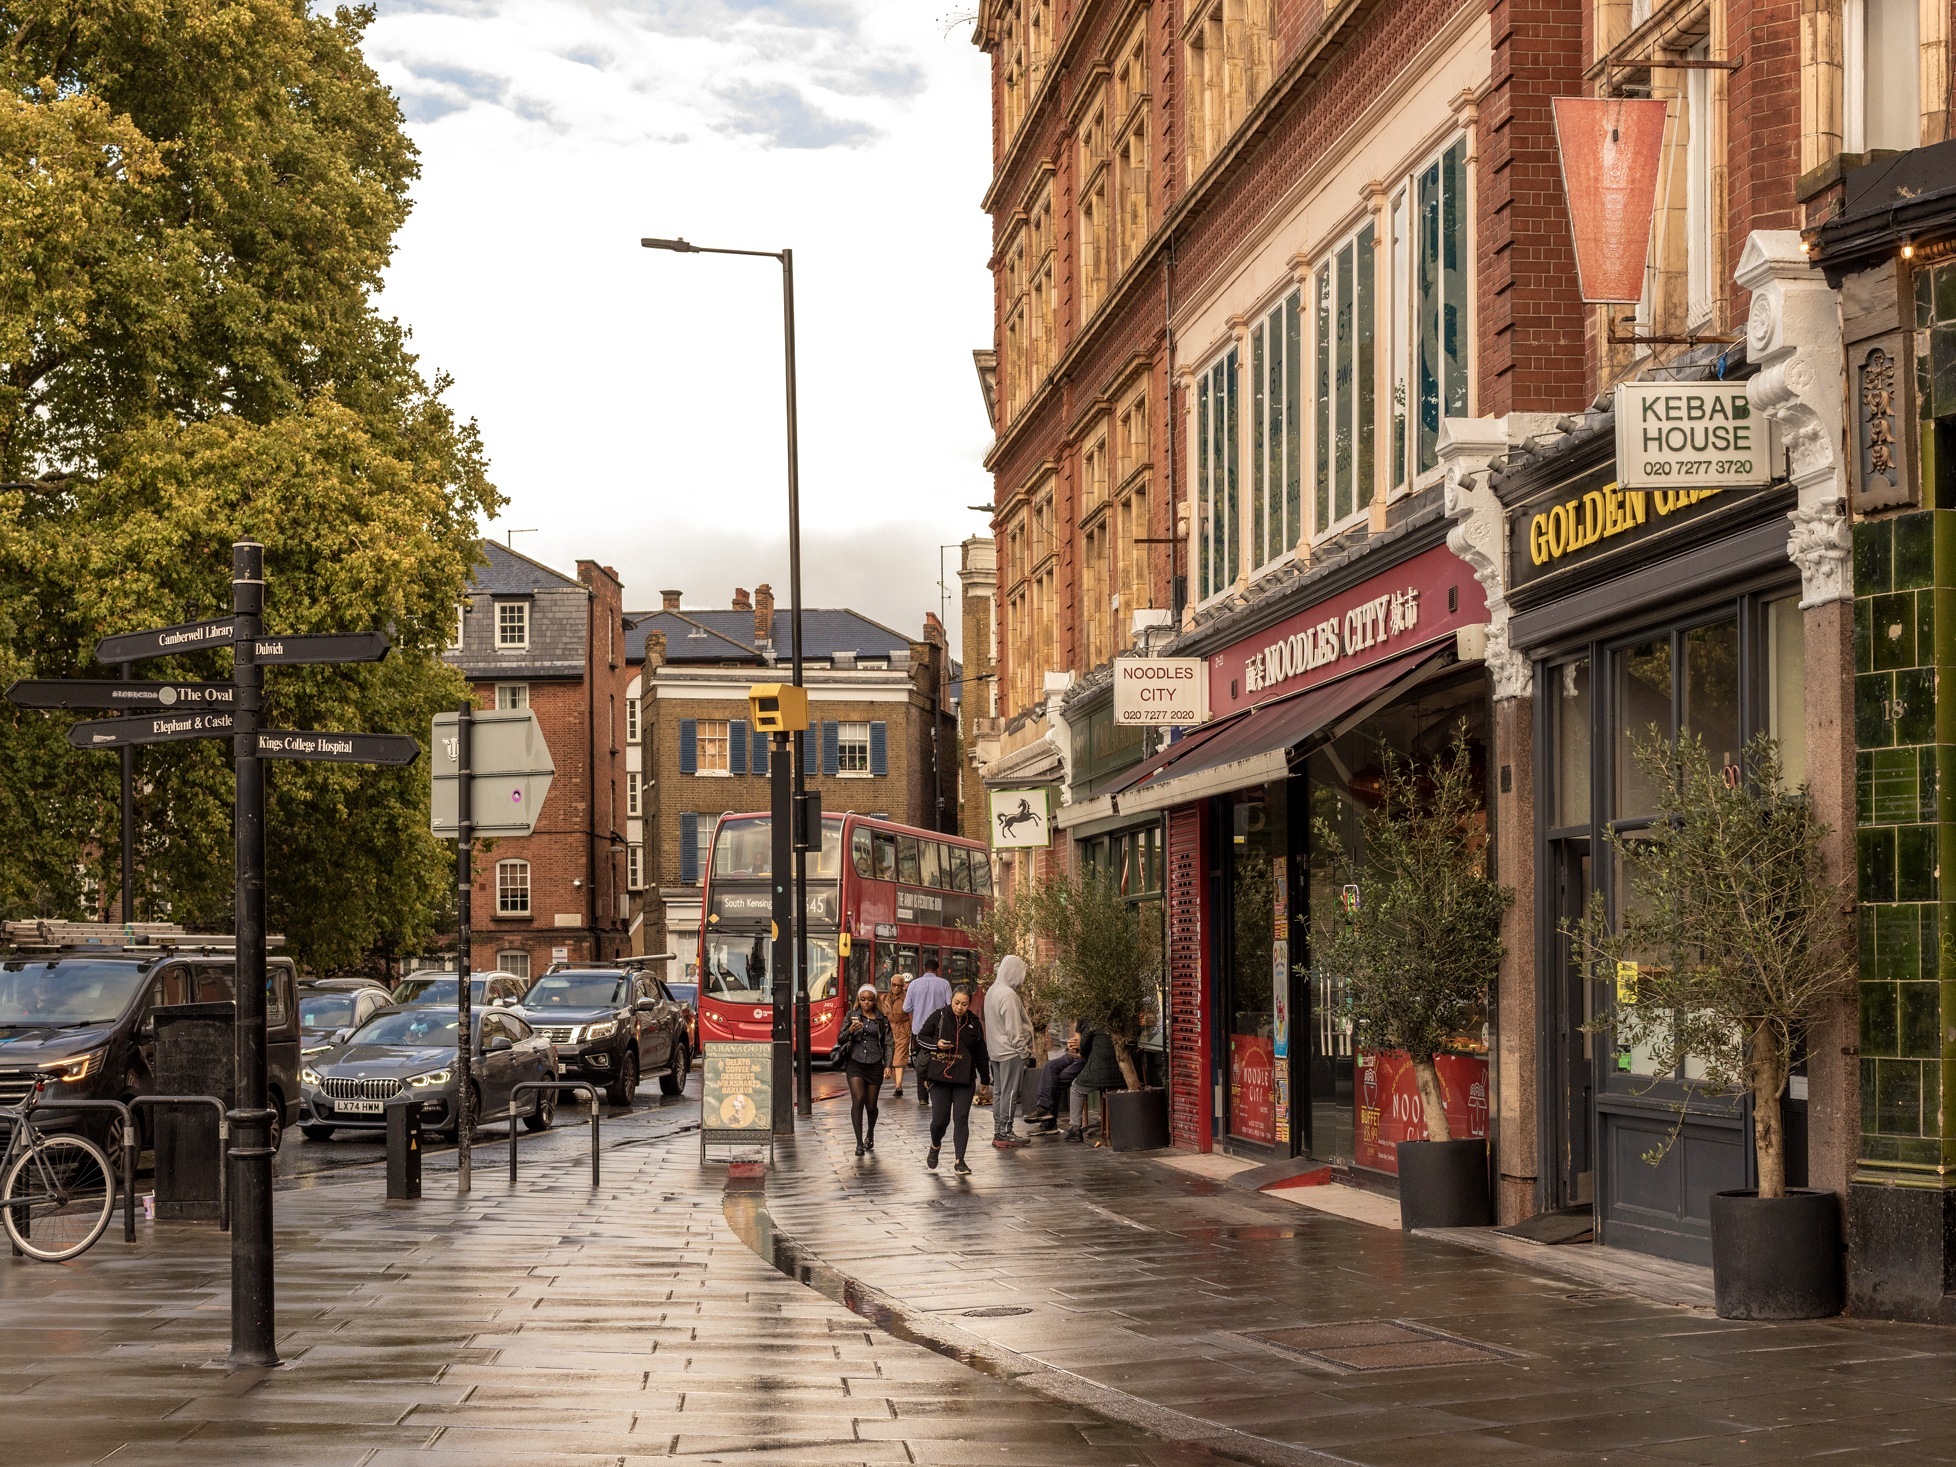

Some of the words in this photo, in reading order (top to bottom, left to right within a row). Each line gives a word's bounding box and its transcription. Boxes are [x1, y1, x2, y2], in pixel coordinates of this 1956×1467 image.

[1641, 395, 1751, 422] KEBAB
[1643, 426, 1752, 453] HOUSE
[1643, 461, 1672, 476] 020
[1676, 460, 1712, 475] 7277
[1715, 459, 1753, 475] 3720
[1530, 481, 1646, 566] GOLDEN
[159, 628, 203, 646] Camberwell
[205, 625, 235, 639] Library
[1264, 617, 1340, 687] NOODLES
[1344, 594, 1390, 656] CITY
[255, 642, 284, 655] Dulwich
[1123, 667, 1194, 680] NOODLES
[177, 688, 202, 701] The
[204, 688, 234, 701] Oval
[1140, 688, 1177, 702] CITY
[1123, 710, 1142, 720] 020
[1144, 710, 1168, 720] 7277
[1170, 710, 1195, 720] 2020
[153, 719, 192, 734] Elephant
[194, 716, 202, 729] &
[204, 714, 233, 728] Castle
[259, 736, 283, 751] Kings
[284, 737, 315, 753] College
[317, 739, 353, 755] Hospital
[724, 898, 745, 908] South
[704, 1045, 772, 1053] CARAVAGGIO
[1243, 1067, 1269, 1088] NOODLE
[721, 1087, 753, 1095] BAKLAVA
[1249, 1086, 1264, 1104] CITY
[337, 1101, 360, 1111] LX74
[362, 1102, 380, 1112] HWM
[1361, 1109, 1380, 1127] BUFFET
